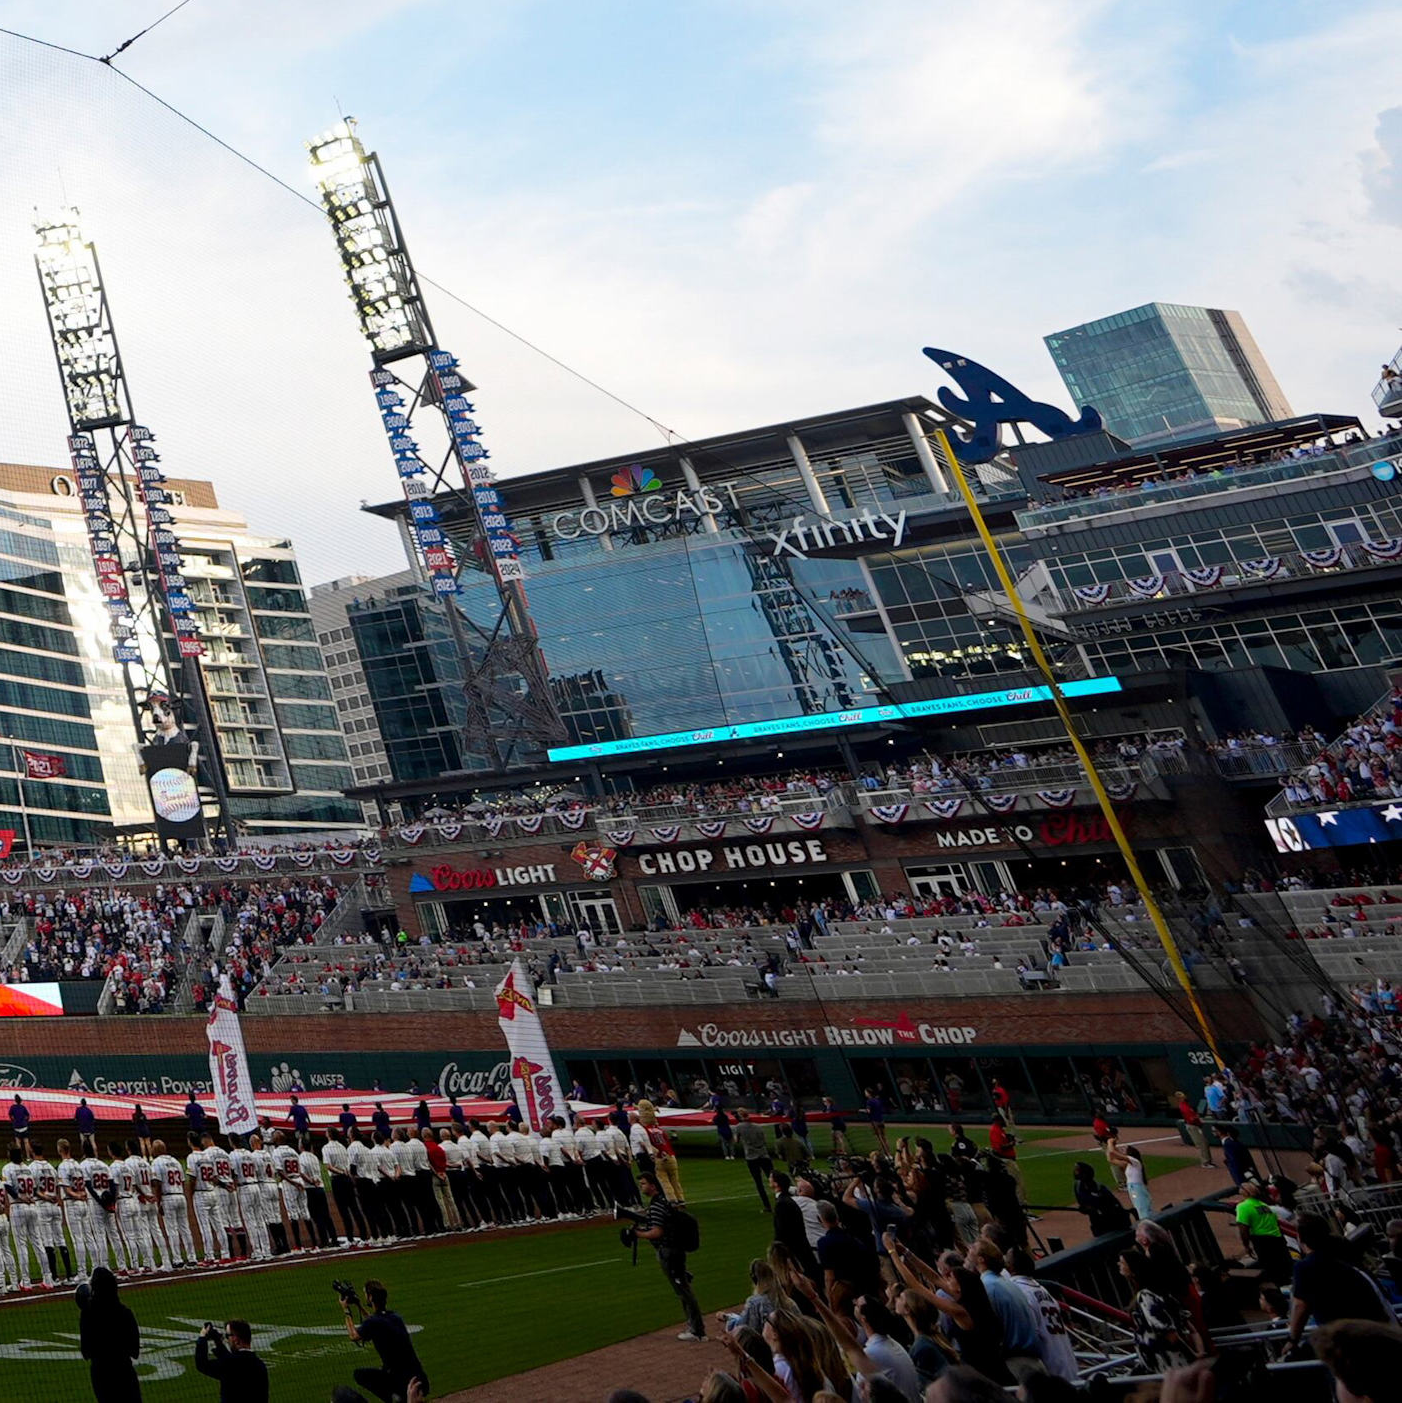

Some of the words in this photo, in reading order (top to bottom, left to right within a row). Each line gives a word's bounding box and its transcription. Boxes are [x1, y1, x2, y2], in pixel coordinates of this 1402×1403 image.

[469, 467, 489, 480] 2012
[406, 483, 426, 495] 2010
[553, 481, 742, 539] COMCAST
[770, 509, 907, 560] xfinity
[499, 564, 521, 576] 2024
[1006, 689, 1033, 703] Chill
[936, 827, 1001, 848] MADE
[1000, 825, 1034, 842] TO
[638, 849, 713, 876] CHOP
[725, 839, 828, 868] HOUSE
[431, 863, 495, 891] Coors
[495, 863, 557, 887] LIGHT
[698, 1022, 763, 1047] Coors
[762, 1028, 817, 1047] LIGHT
[824, 1025, 894, 1046] BELOW
[897, 1029, 915, 1040] THE
[919, 1023, 977, 1045] CHOP
[1187, 1051, 1214, 1065] 325
[93, 1076, 158, 1096] Georgia
[162, 1076, 214, 1095] Power
[310, 1073, 345, 1088] KAISER
[167, 1170, 182, 1185] 83
